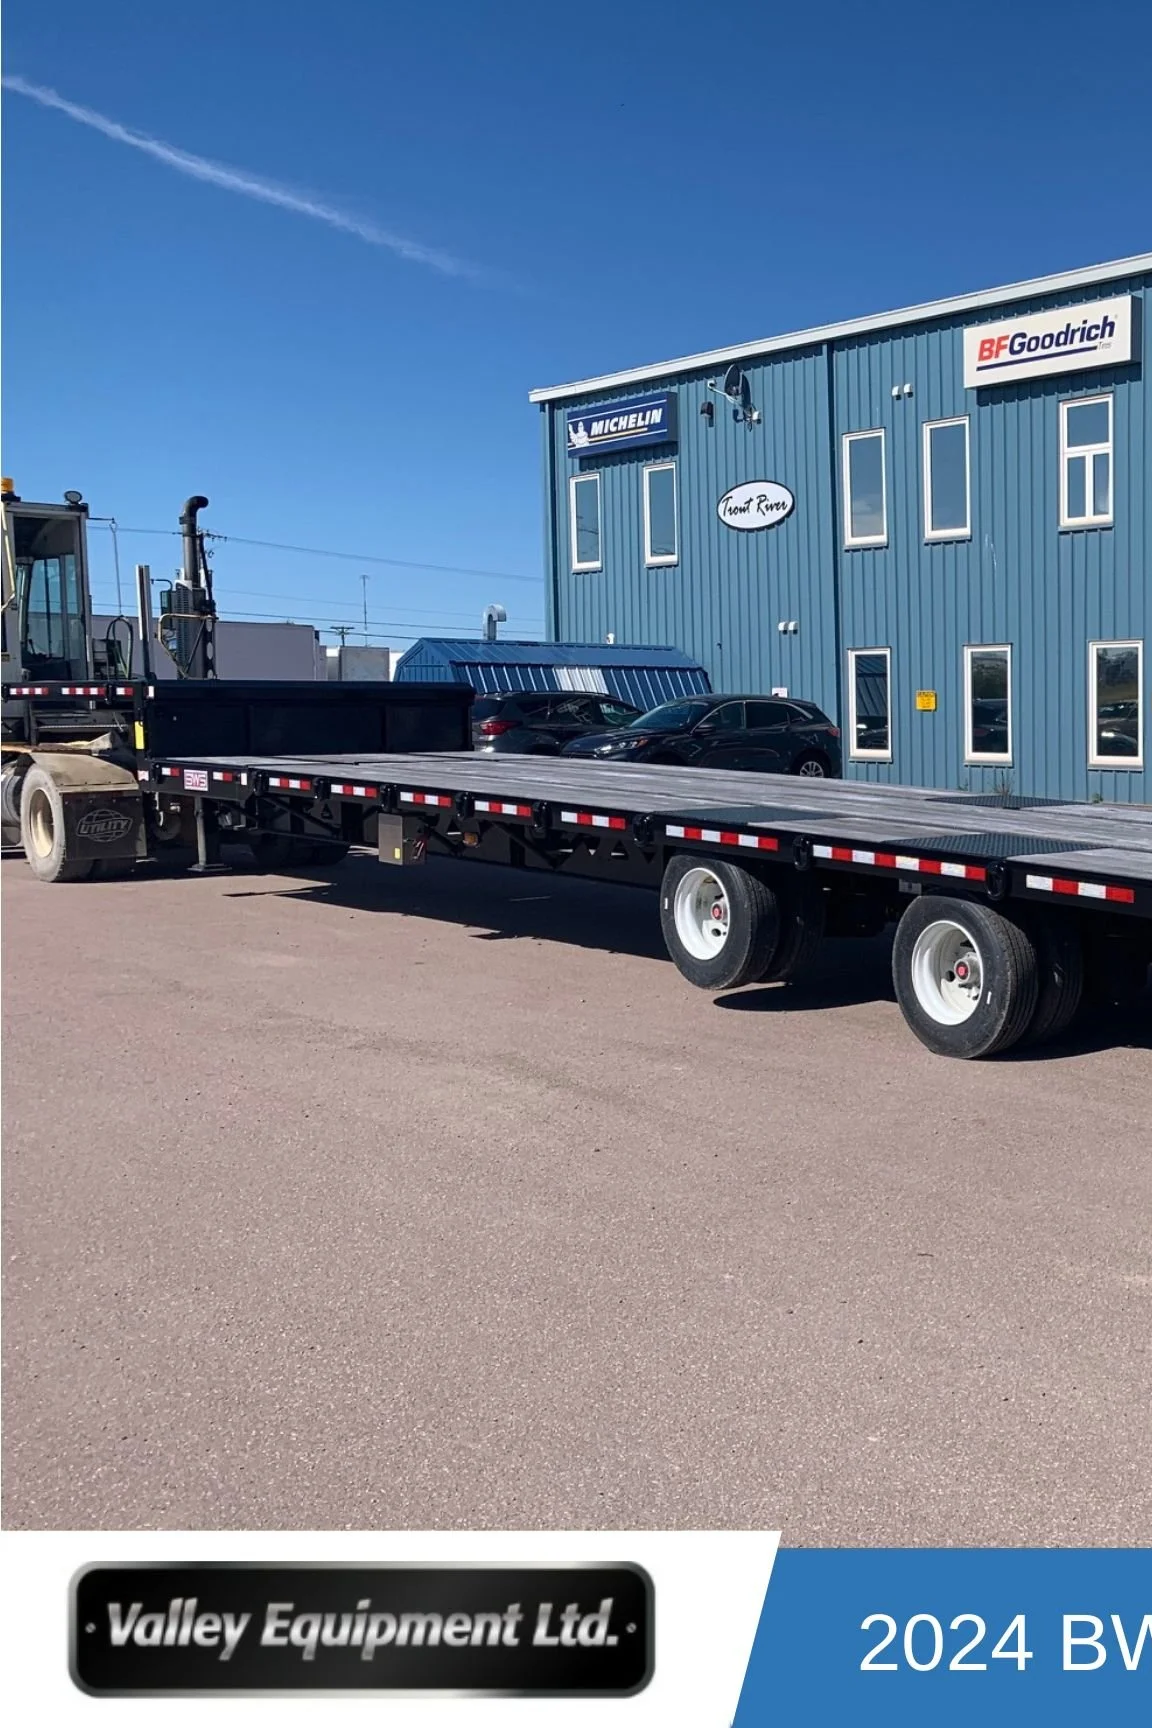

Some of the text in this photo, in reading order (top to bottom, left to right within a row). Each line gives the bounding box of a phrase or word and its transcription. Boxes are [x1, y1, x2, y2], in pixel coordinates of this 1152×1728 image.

[978, 315, 1116, 362] BFGoodrich
[590, 408, 663, 437] MICHELIN
[722, 495, 788, 517] Trout River
[80, 819, 129, 834] UTILITY
